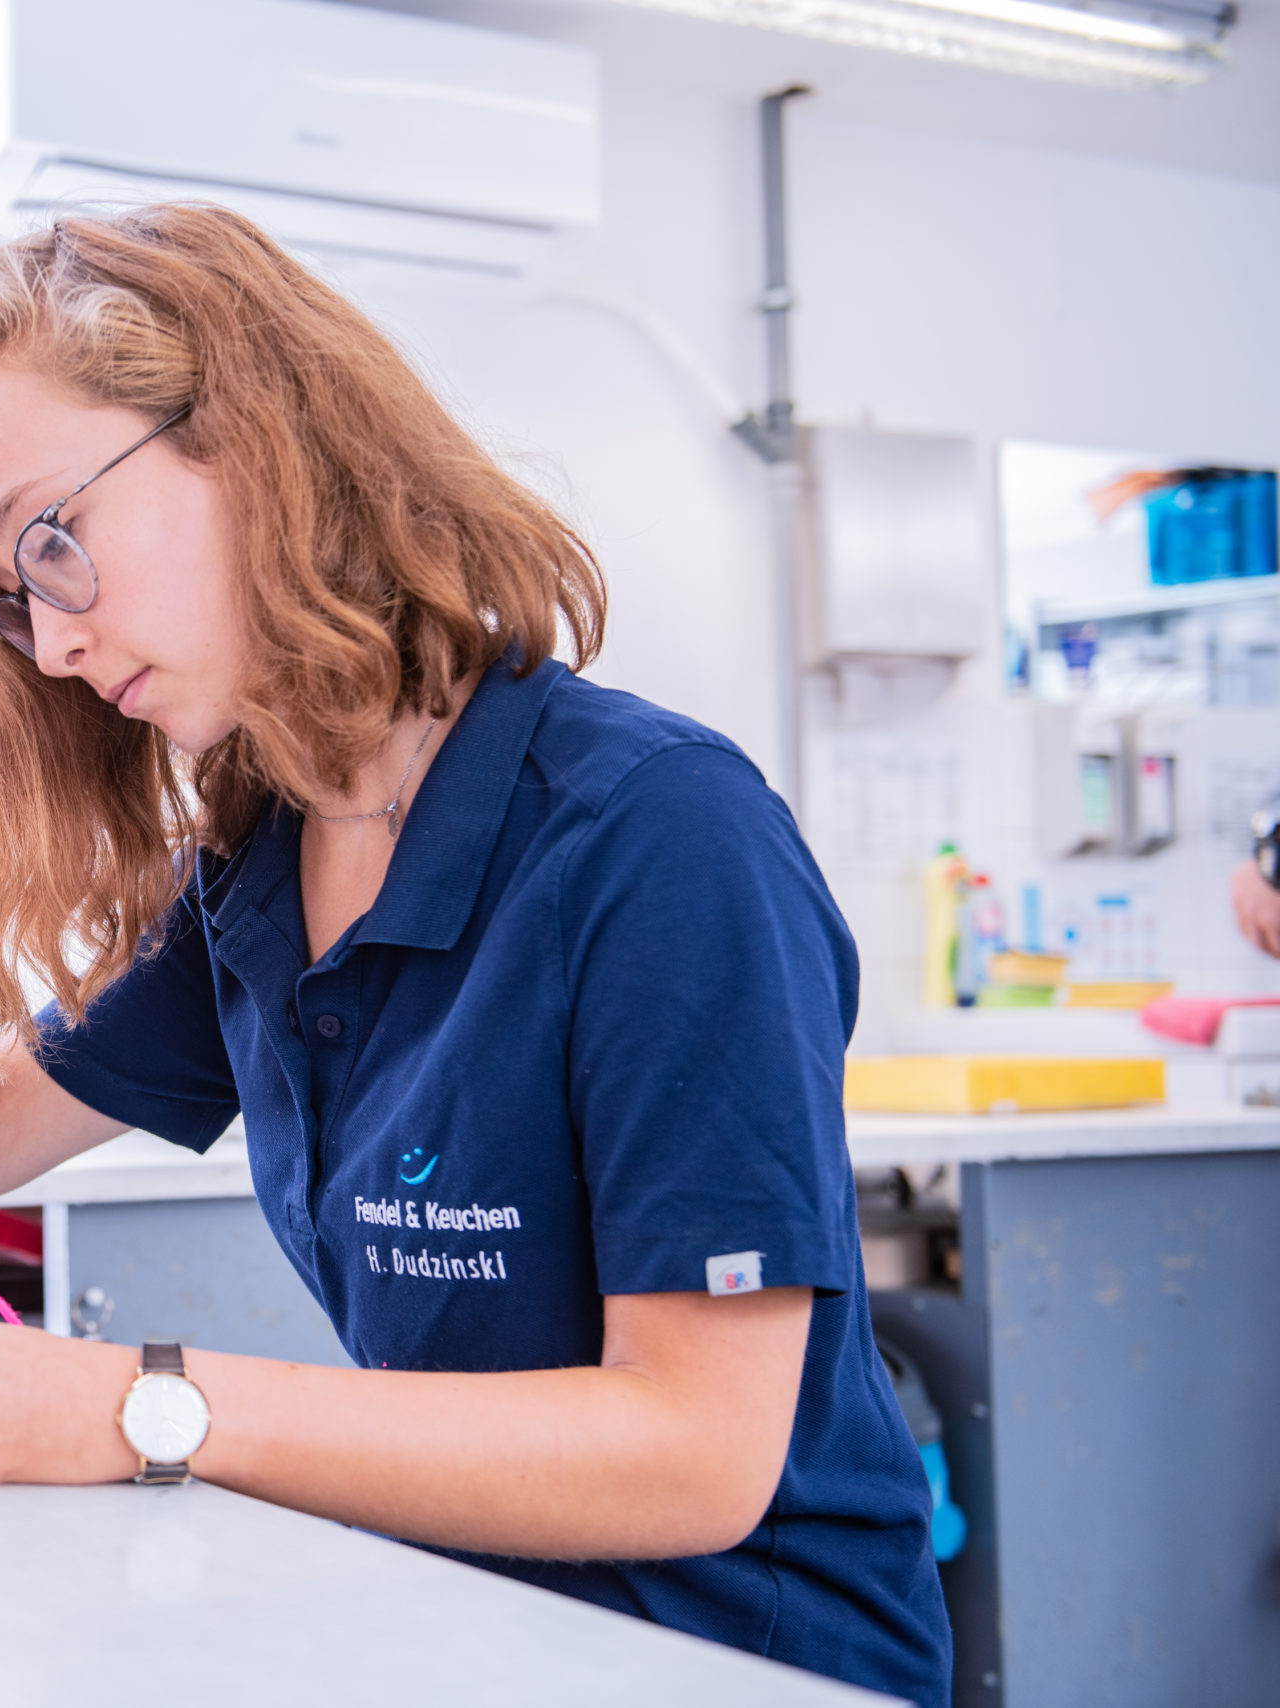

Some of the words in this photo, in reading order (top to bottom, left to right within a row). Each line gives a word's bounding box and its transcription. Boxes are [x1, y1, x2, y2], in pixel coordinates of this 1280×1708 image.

[354, 1195, 402, 1228] Fendel
[405, 1200, 421, 1229] &
[425, 1201, 521, 1232] Keuchen
[365, 1245, 388, 1274] H.
[392, 1247, 507, 1281] Dudzinski
